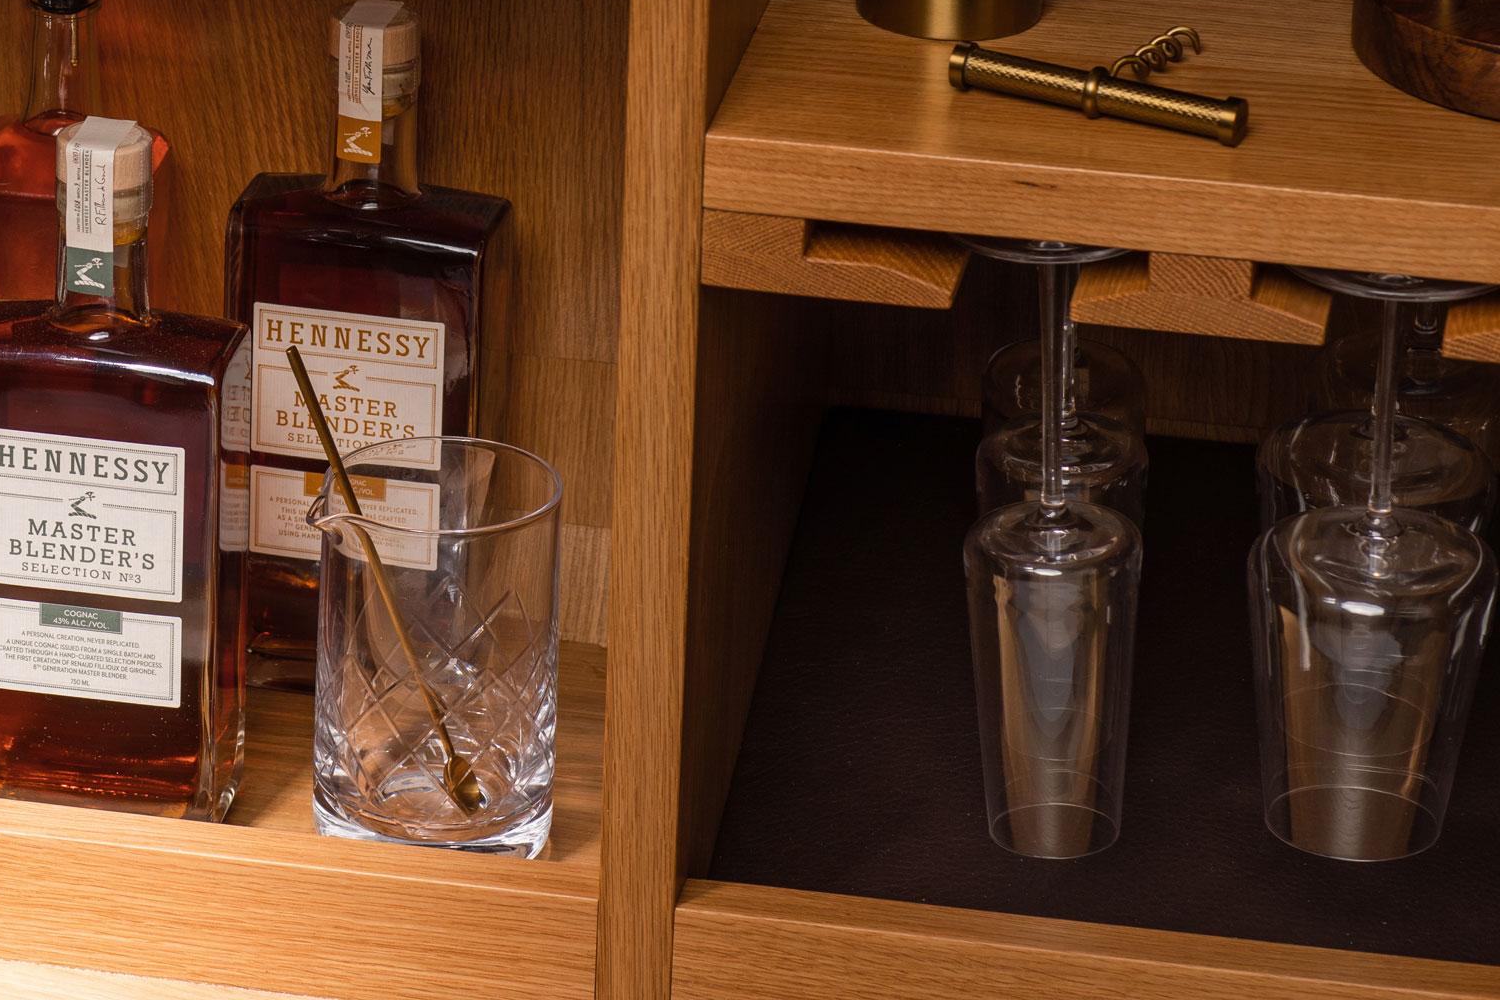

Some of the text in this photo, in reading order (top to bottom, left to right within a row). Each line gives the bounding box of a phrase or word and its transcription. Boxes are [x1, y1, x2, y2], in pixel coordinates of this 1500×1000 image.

[265, 318, 431, 359] HENNESSY
[287, 432, 374, 451] SELETIO
[275, 497, 310, 507] PERSONAL
[27, 518, 137, 547] MASTER
[8, 538, 156, 571] BLENDER'S
[21, 561, 112, 581] SELECTION
[52, 617, 70, 625] 43%
[63, 609, 99, 620] COGNAC
[26, 631, 55, 640] PERSONAL
[11, 639, 33, 648] UNIQUE
[34, 641, 59, 650] COGNAC
[80, 646, 97, 654] FROM
[102, 649, 122, 657] SINGLE
[123, 651, 142, 659] BATCH
[143, 653, 156, 661] AND
[25, 647, 53, 657] THROUGH
[105, 656, 136, 667] SELECTION
[17, 654, 31, 662] FIRST
[32, 656, 61, 665] CREATION
[61, 658, 69, 666] OF
[41, 664, 78, 674] GENERATION
[78, 668, 101, 677] MASTER
[81, 679, 91, 687] ML
